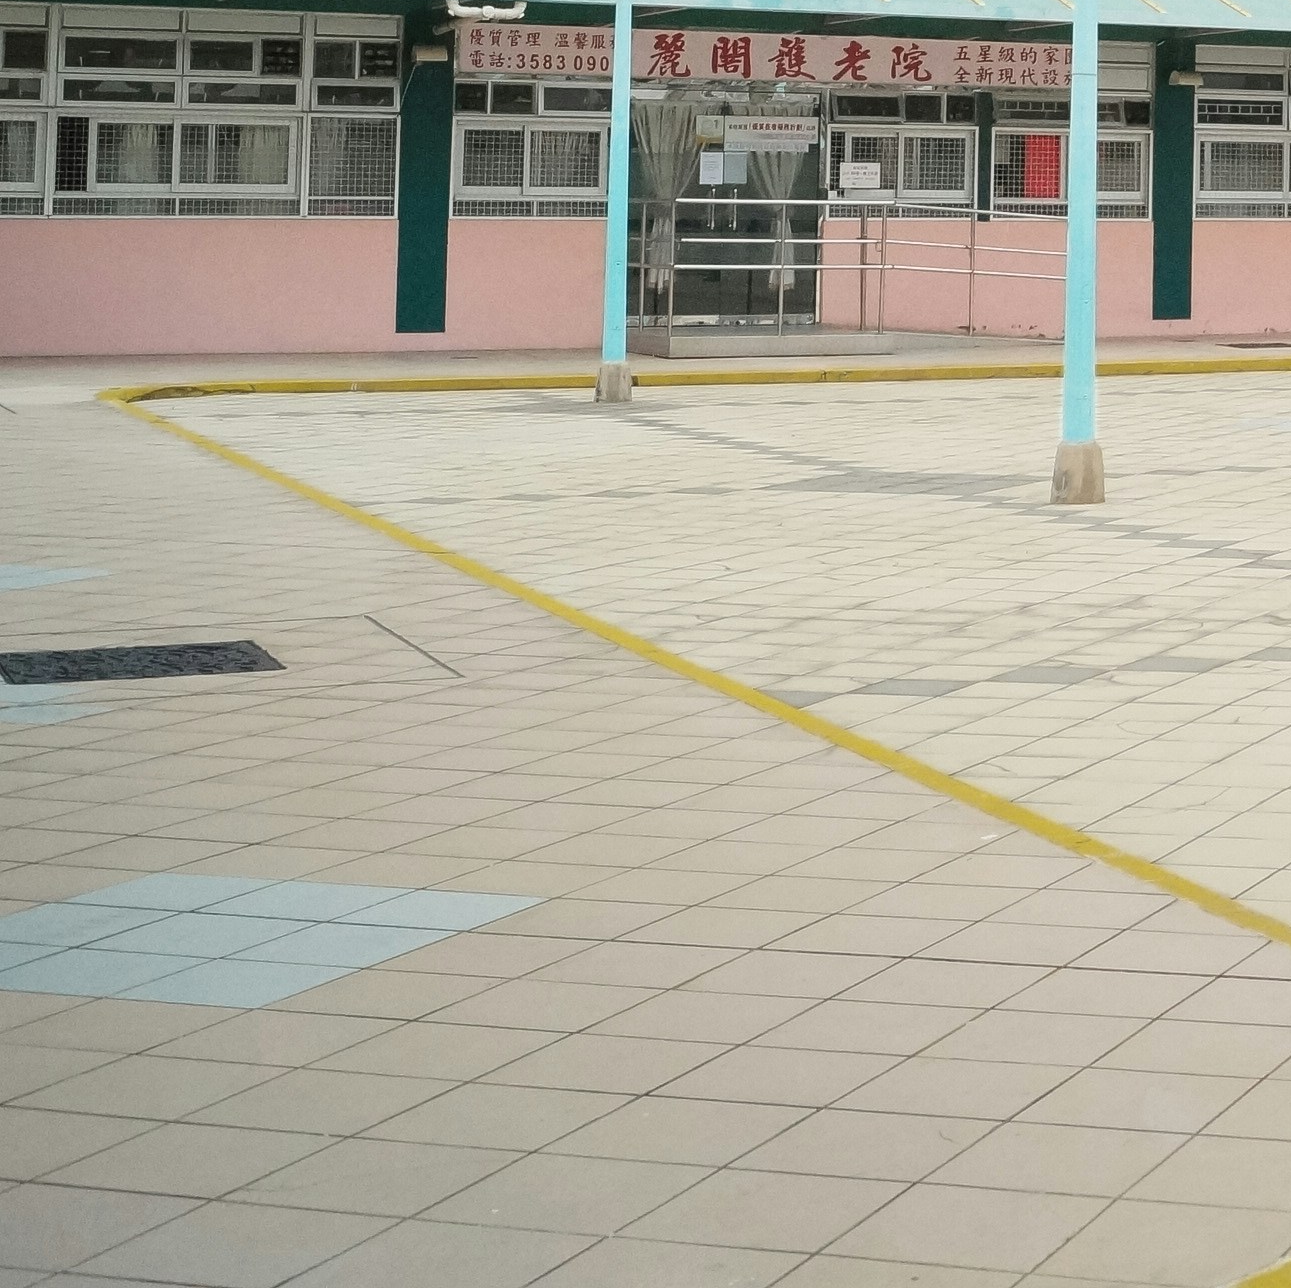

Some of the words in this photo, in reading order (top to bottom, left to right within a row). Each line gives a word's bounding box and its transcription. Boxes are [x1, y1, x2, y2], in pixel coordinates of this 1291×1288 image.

[469, 28, 541, 47] 優質管理
[554, 32, 614, 50] 溫馨服
[573, 54, 610, 72] 090
[647, 32, 932, 82] 麗閣護老院
